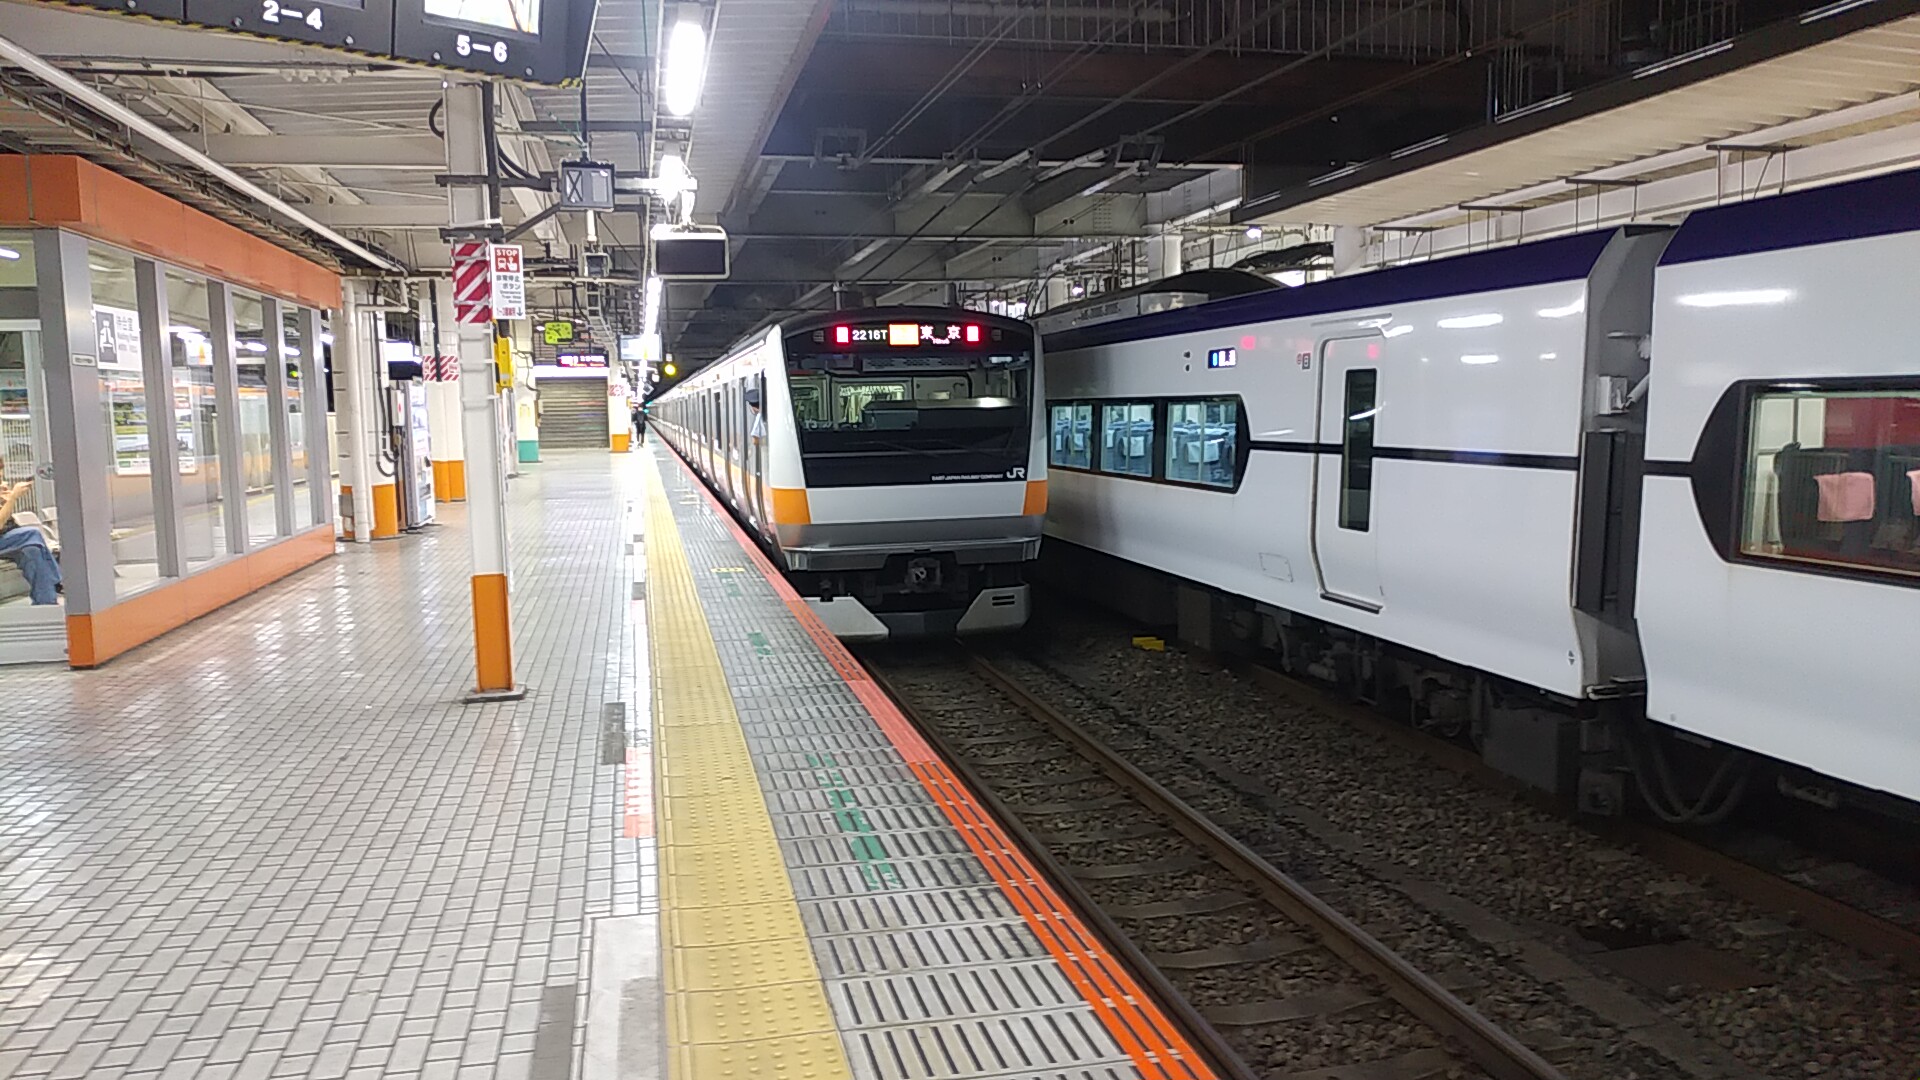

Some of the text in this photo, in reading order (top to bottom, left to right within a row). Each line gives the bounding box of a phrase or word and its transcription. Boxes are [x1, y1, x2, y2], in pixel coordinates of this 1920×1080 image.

[496, 249, 518, 257] STOP
[852, 329, 887, 341] 2216T
[1006, 467, 1025, 479] JR
